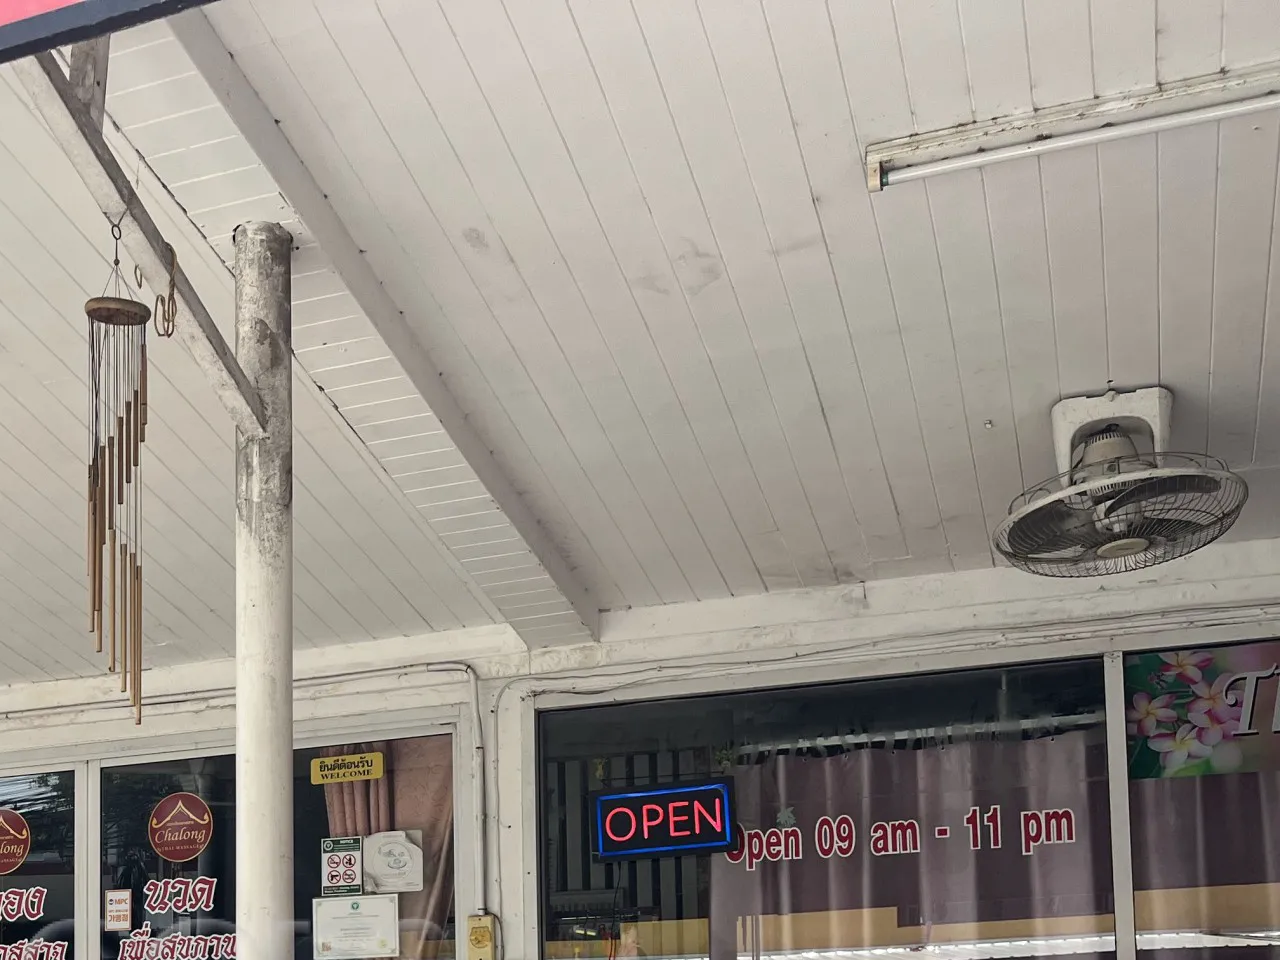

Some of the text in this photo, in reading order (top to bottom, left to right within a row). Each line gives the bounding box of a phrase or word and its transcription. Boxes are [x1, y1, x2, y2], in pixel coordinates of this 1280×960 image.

[319, 756, 373, 772] ยินดีต้อนรับ
[321, 769, 373, 780] WELCOME
[605, 798, 722, 842] OPEN
[815, 814, 856, 859] 09
[870, 819, 921, 856] am
[964, 805, 1002, 850] 11
[1020, 808, 1076, 856] pm
[155, 826, 206, 844] Chalong
[144, 876, 218, 914] นวด
